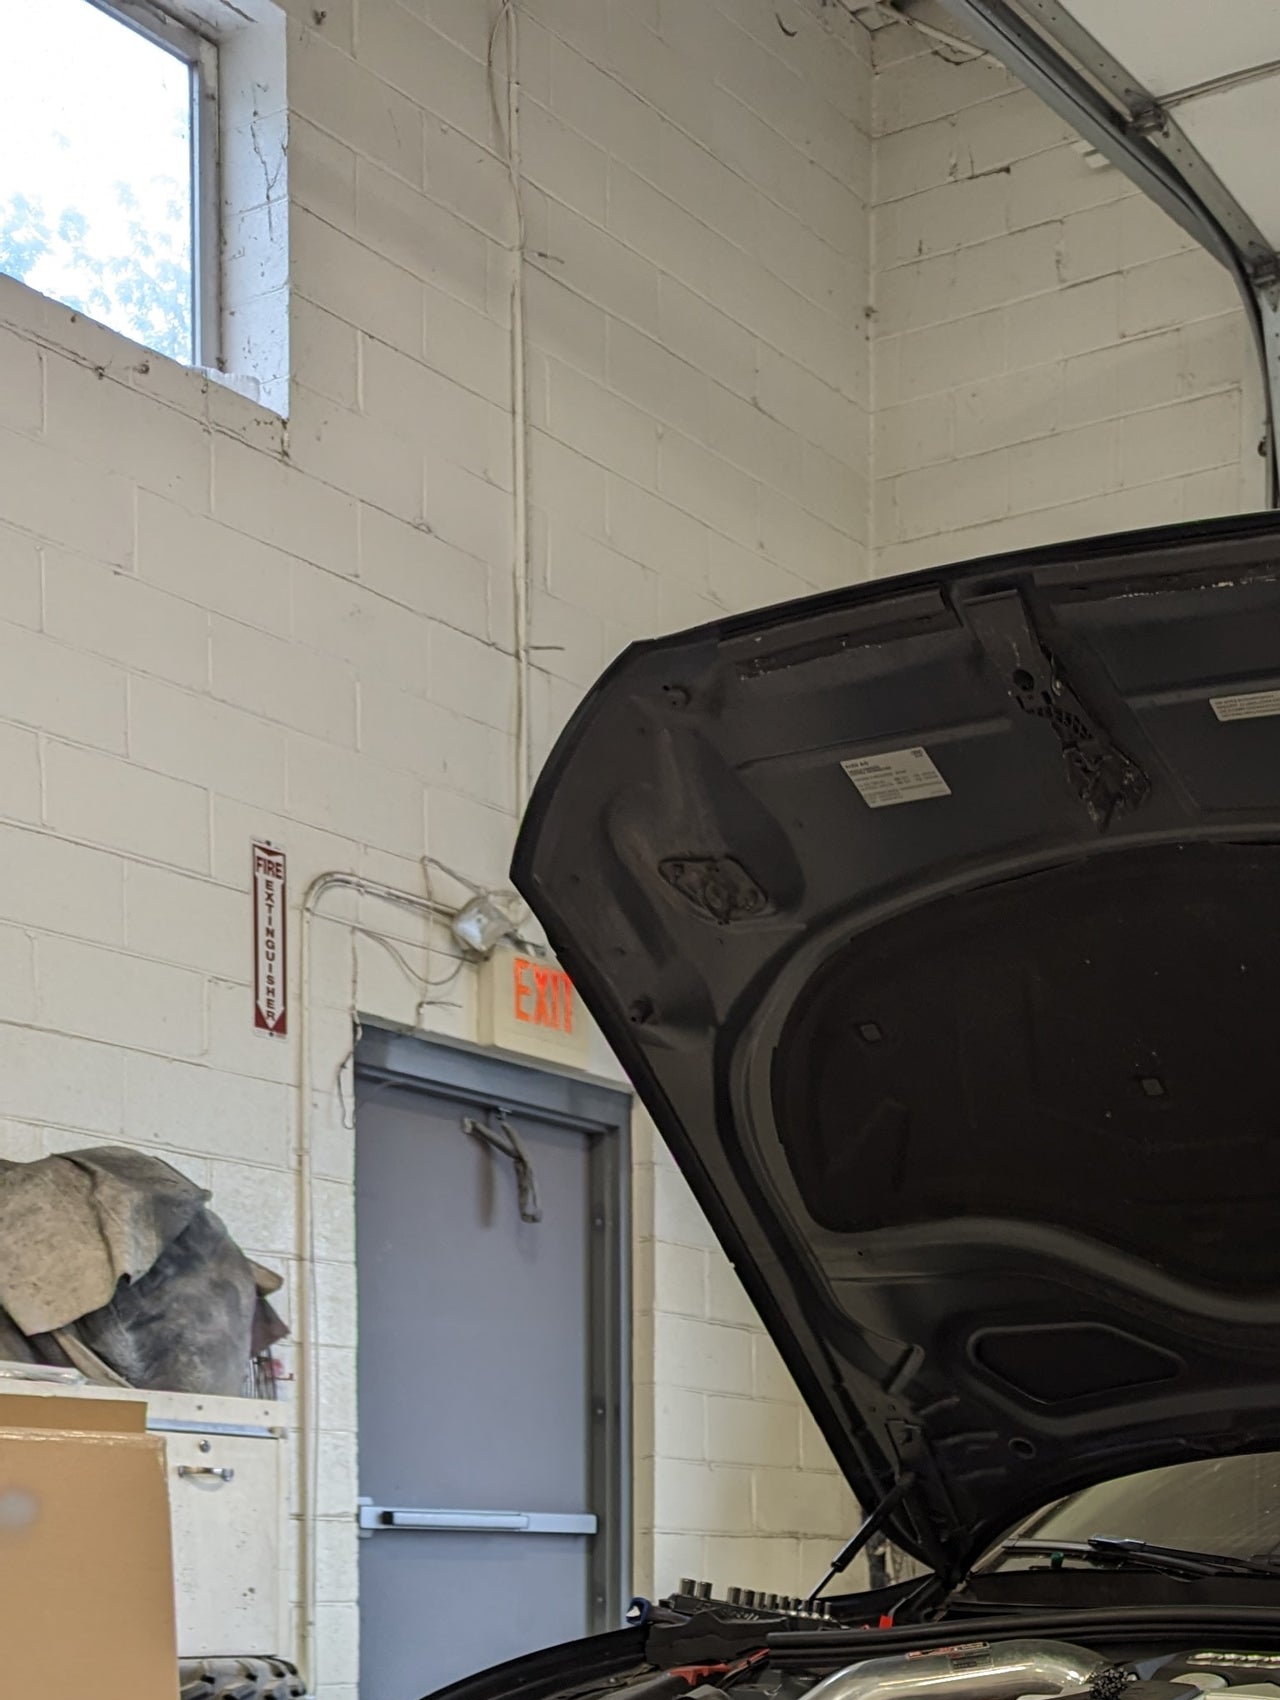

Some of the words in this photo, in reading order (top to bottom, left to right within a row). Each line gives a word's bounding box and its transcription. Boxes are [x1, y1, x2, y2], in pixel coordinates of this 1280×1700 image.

[256, 856, 283, 880] FIRE
[265, 879, 276, 1022] EXTINGUISHER
[514, 957, 573, 1035] EXIT
